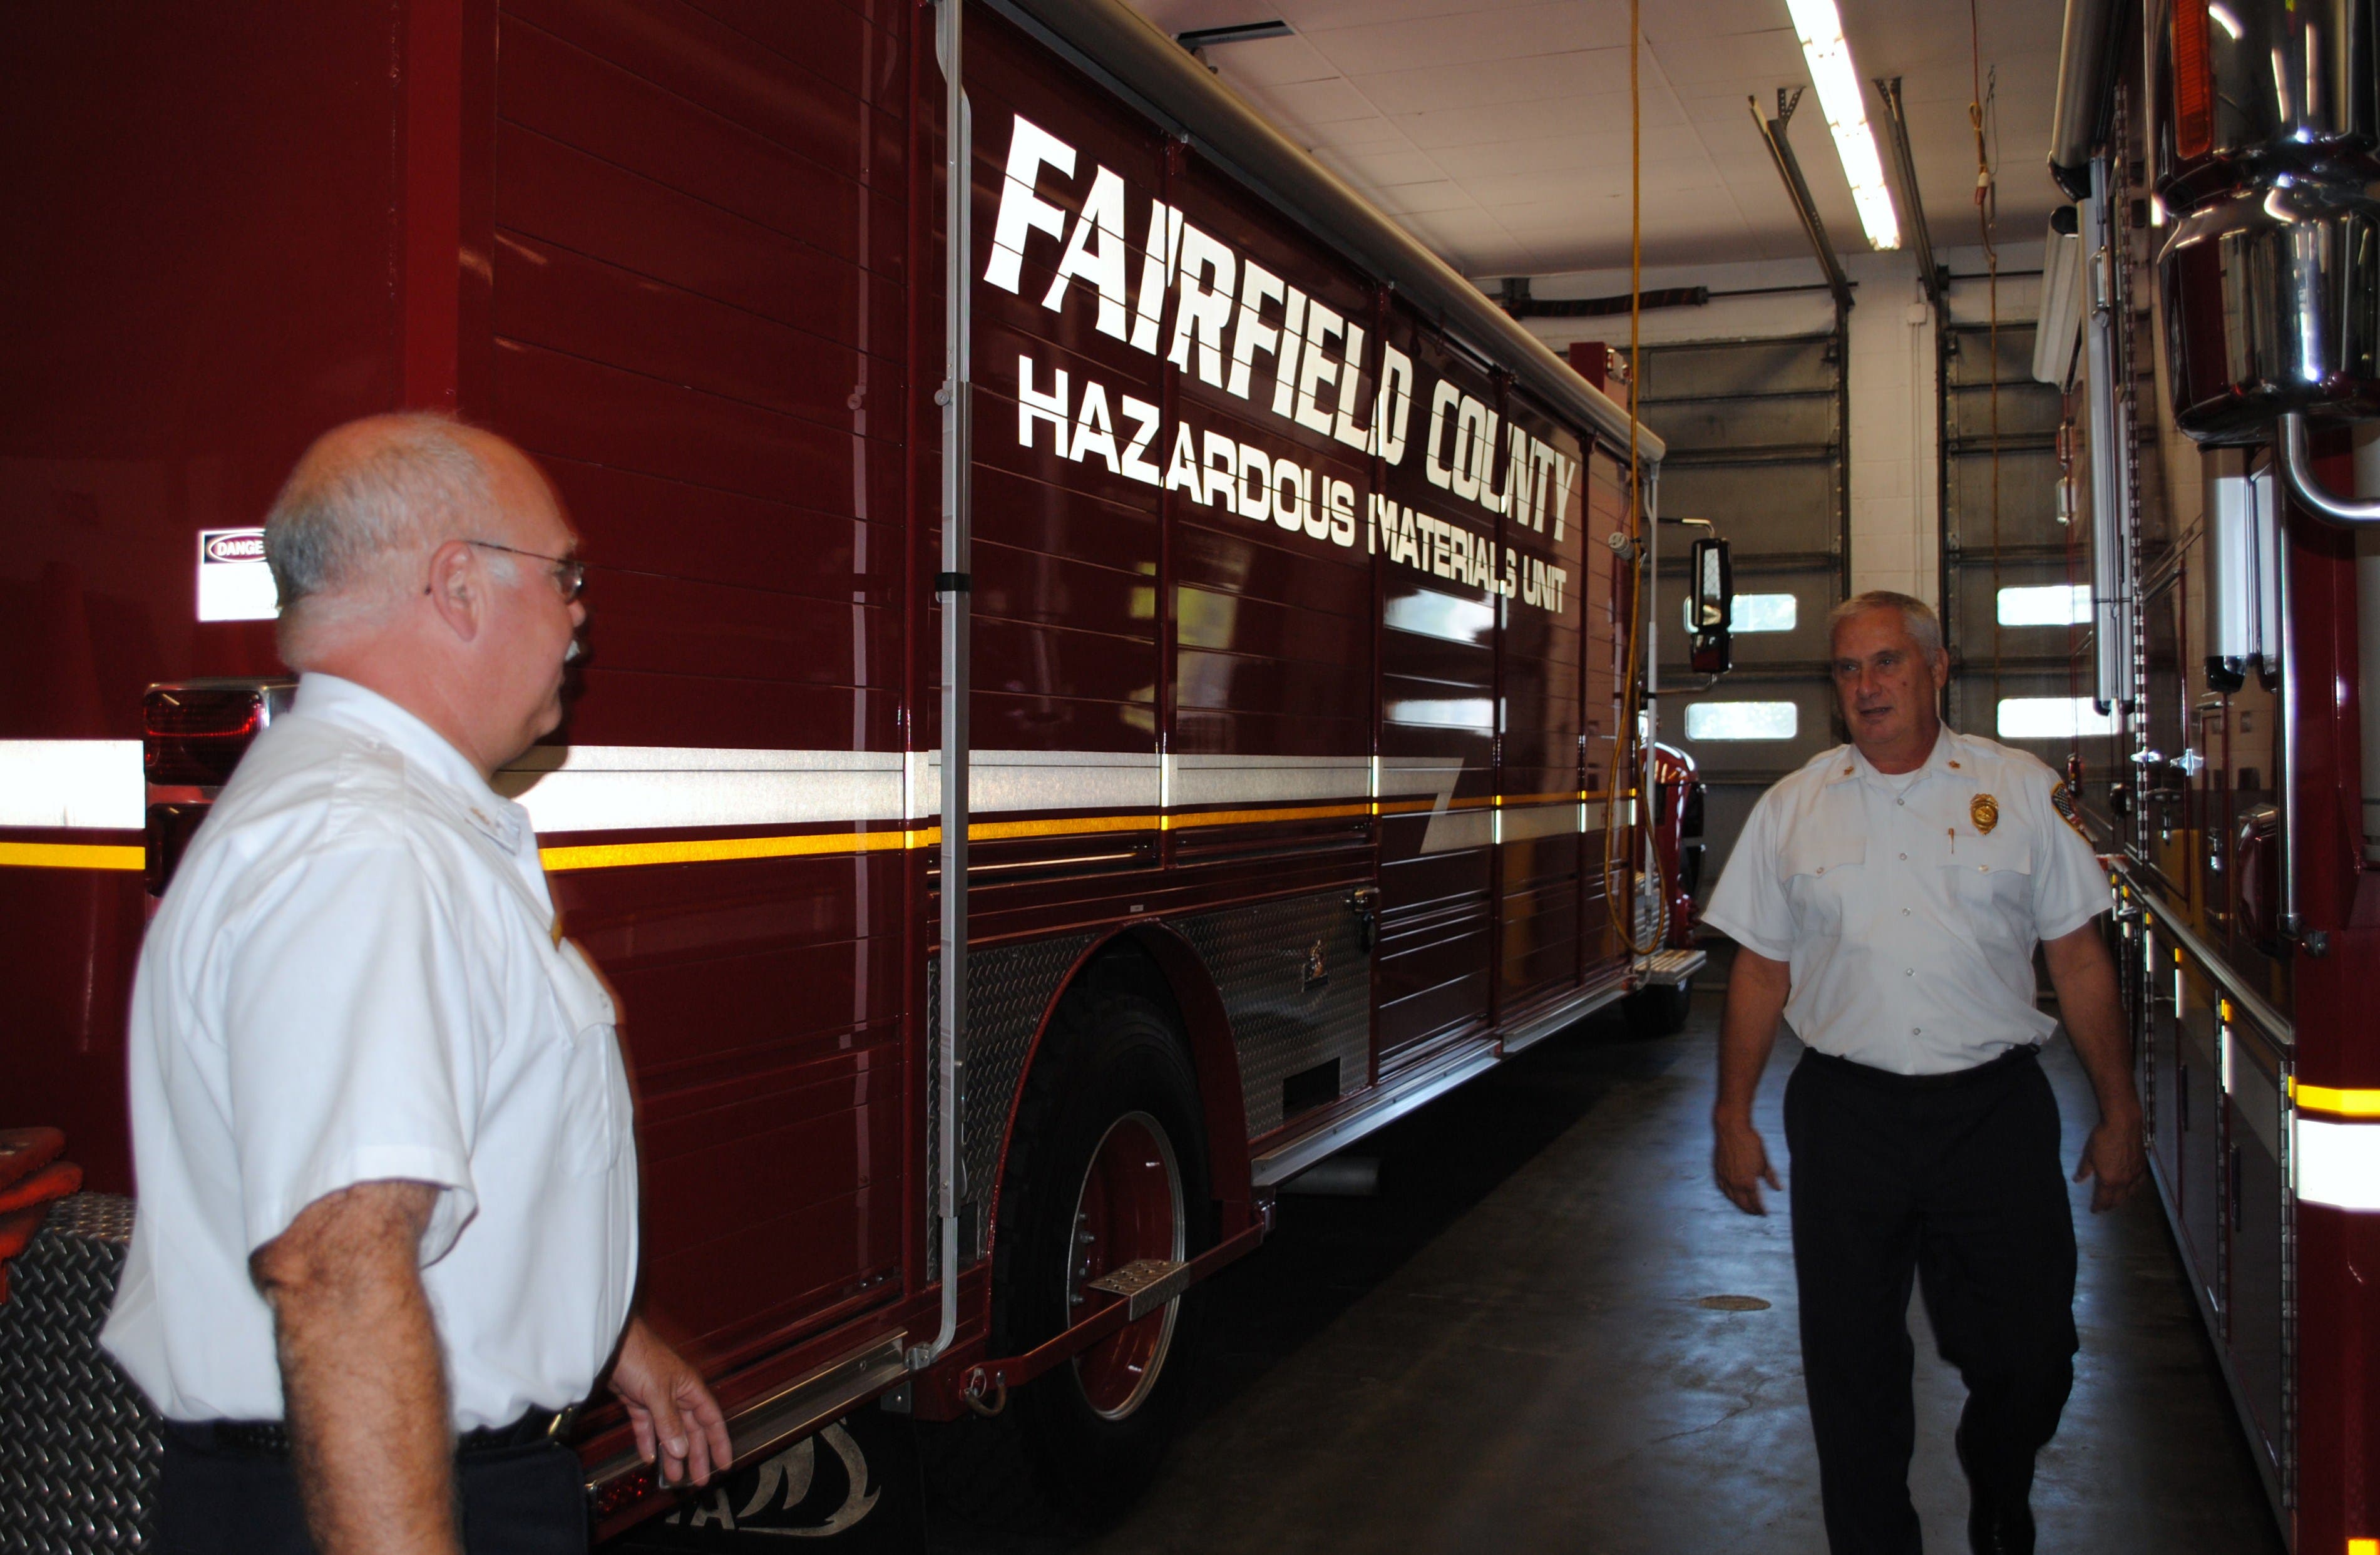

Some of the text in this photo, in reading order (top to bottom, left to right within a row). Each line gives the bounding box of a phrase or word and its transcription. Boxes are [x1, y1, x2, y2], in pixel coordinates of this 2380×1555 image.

[983, 114, 1576, 542] FAIRFIELD COUNTY
[218, 541, 264, 556] DANGE
[1018, 355, 1567, 613] HAZARDOUS MATERIALS UNIT
